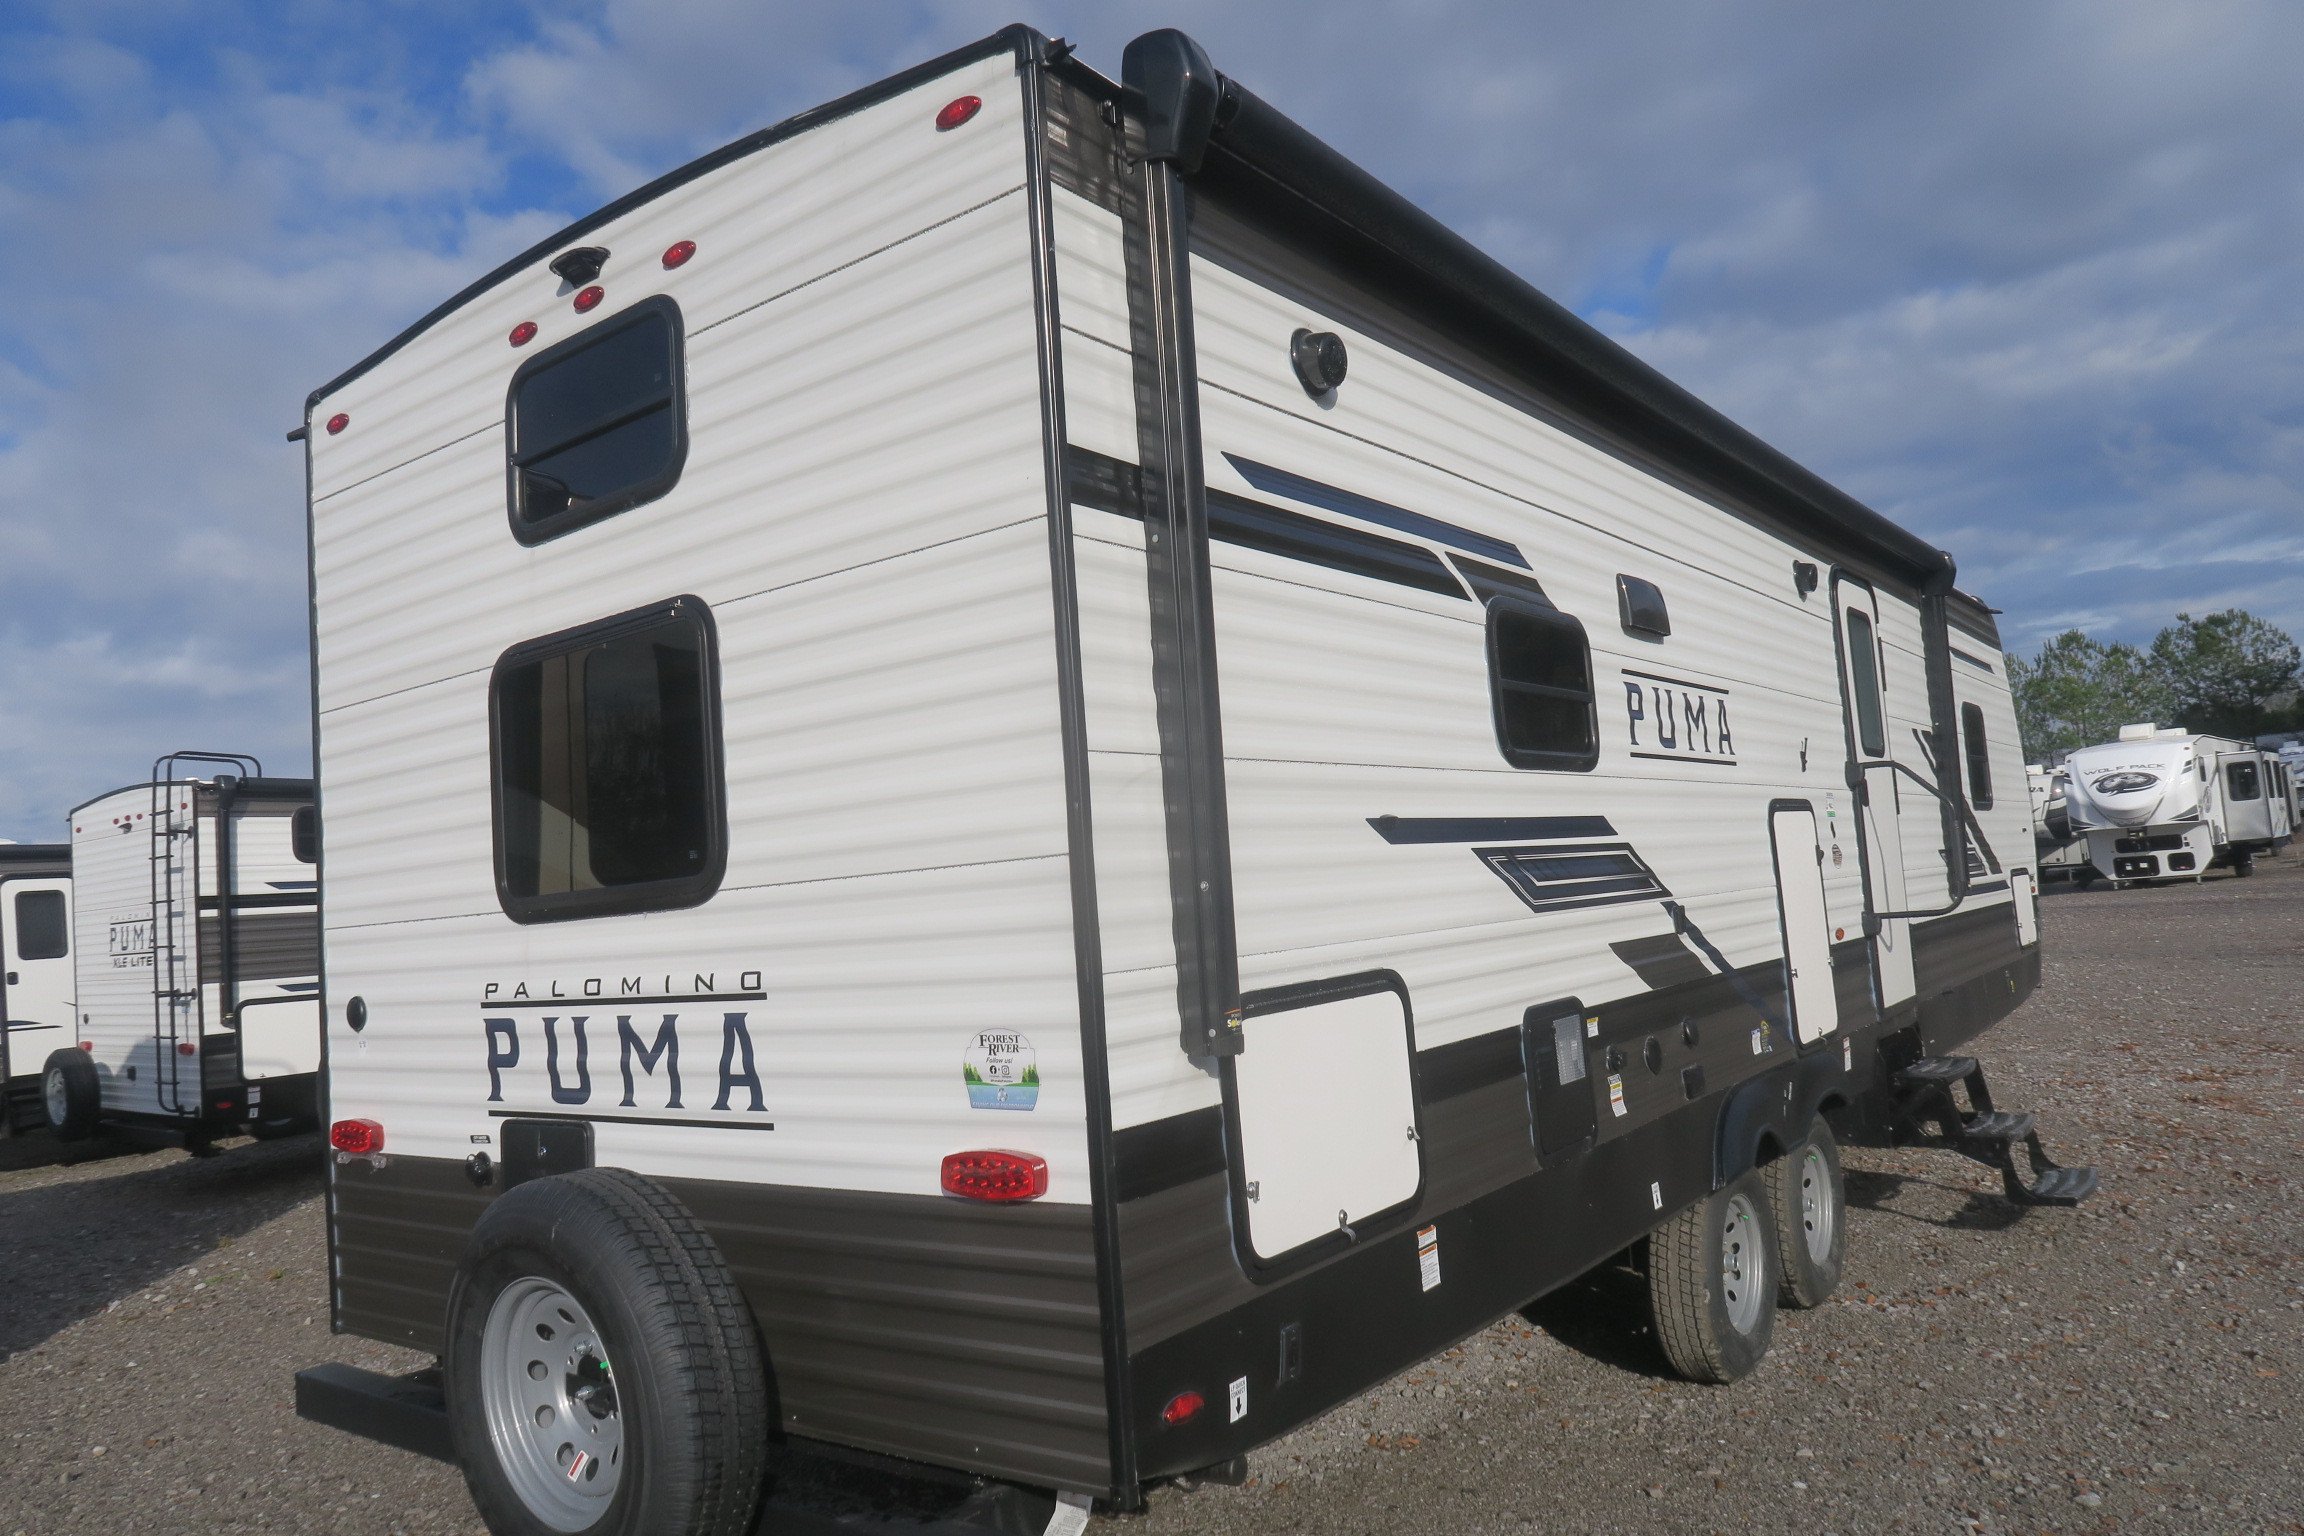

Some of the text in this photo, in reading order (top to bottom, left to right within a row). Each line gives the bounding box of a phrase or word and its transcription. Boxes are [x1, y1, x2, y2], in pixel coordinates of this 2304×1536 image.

[1623, 681, 1736, 755] PUMA
[2083, 766, 2125, 776] WOLF
[131, 956, 154, 967] LITE
[485, 971, 762, 999] PALOMINO
[979, 1034, 1021, 1047] FOREST
[988, 1044, 1020, 1056] RIVER
[483, 1012, 769, 1111] PUMA
